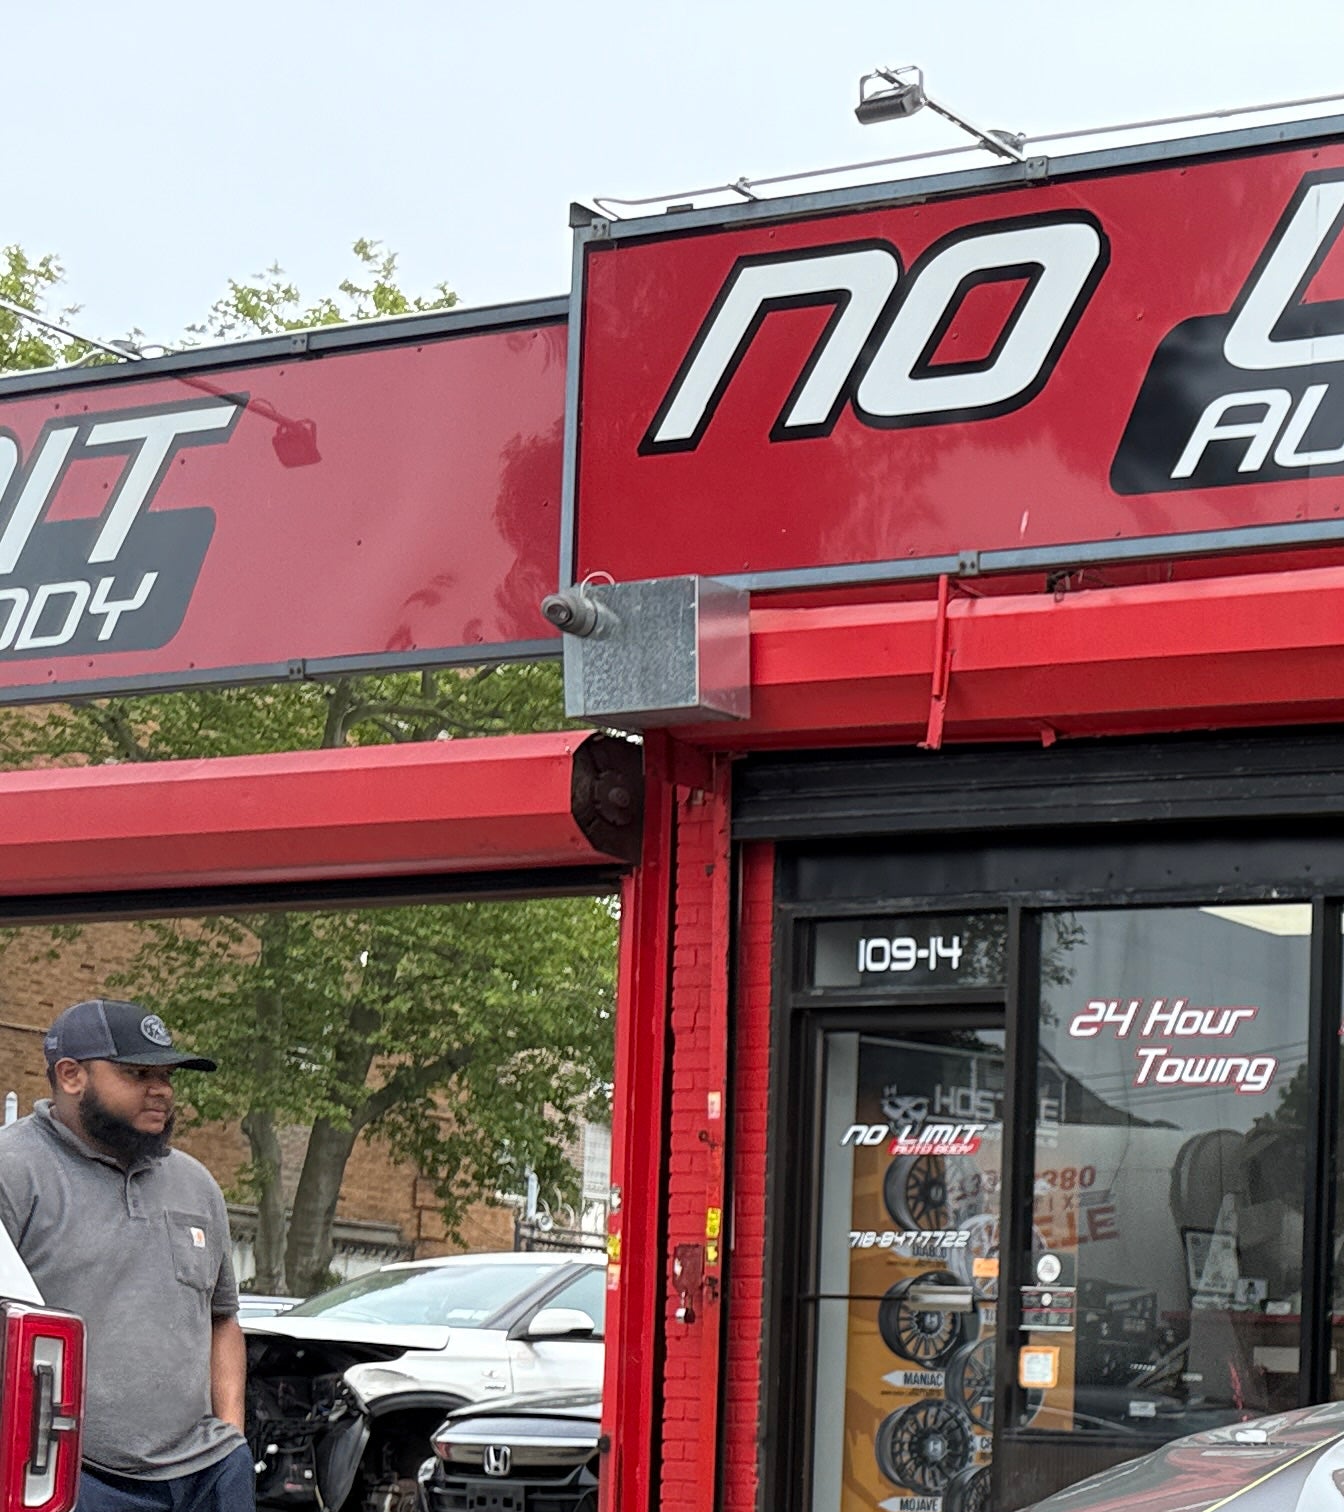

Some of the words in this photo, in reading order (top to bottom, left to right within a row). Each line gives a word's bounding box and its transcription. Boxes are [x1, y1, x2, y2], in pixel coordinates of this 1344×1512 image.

[857, 935, 963, 973] 109-14
[1069, 1000, 1138, 1038] 24
[1142, 999, 1256, 1038] Hour
[1134, 1046, 1278, 1093] Towing
[897, 1123, 987, 1146] LIMIT
[903, 1372, 944, 1387] MANIAC
[899, 1497, 939, 1512] MOJAVE
